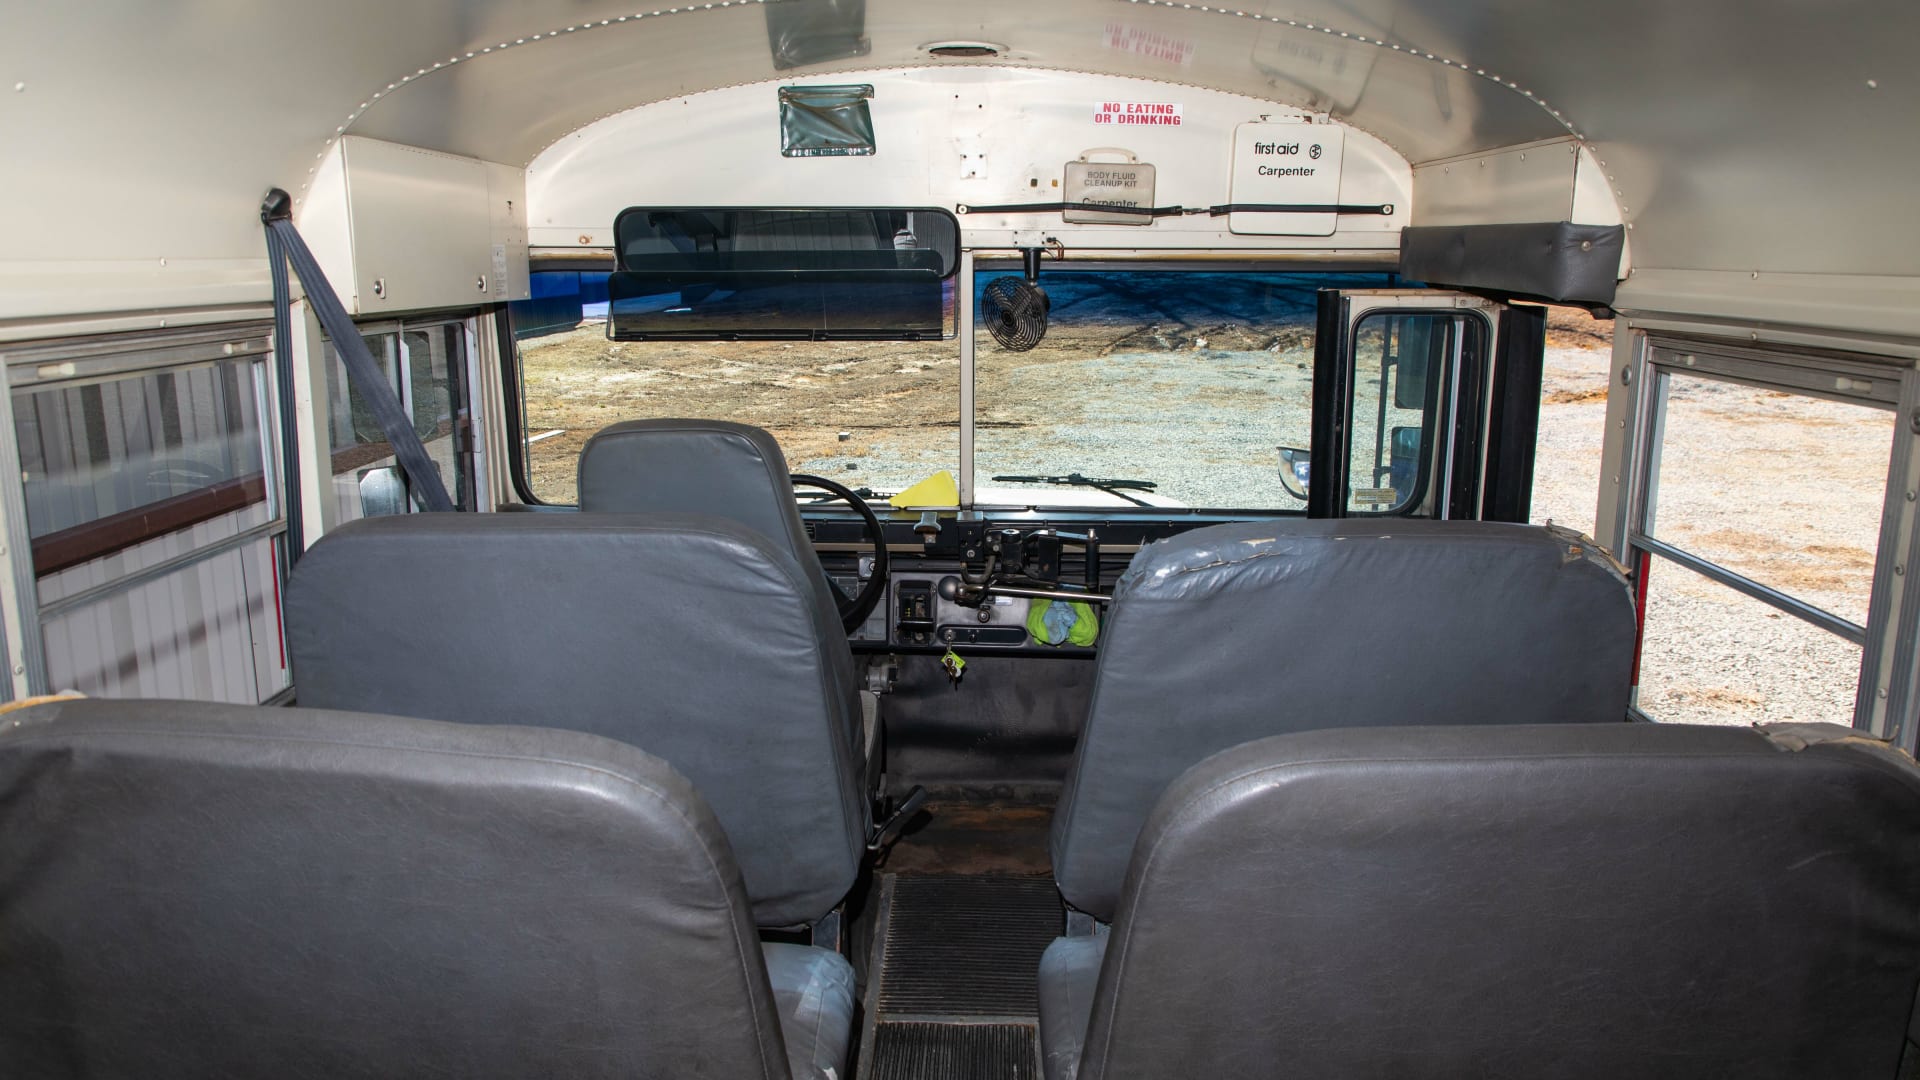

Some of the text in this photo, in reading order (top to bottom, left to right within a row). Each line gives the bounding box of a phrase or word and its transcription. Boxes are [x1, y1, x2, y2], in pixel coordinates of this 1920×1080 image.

[1103, 102, 1174, 115] NO EATING
[1094, 113, 1181, 125] OR DRINKING
[1254, 141, 1299, 155] first aid
[1087, 171, 1136, 180] BODY FLUID
[1258, 165, 1315, 178] Carpenter
[1084, 179, 1138, 188] CLEANUP KIT
